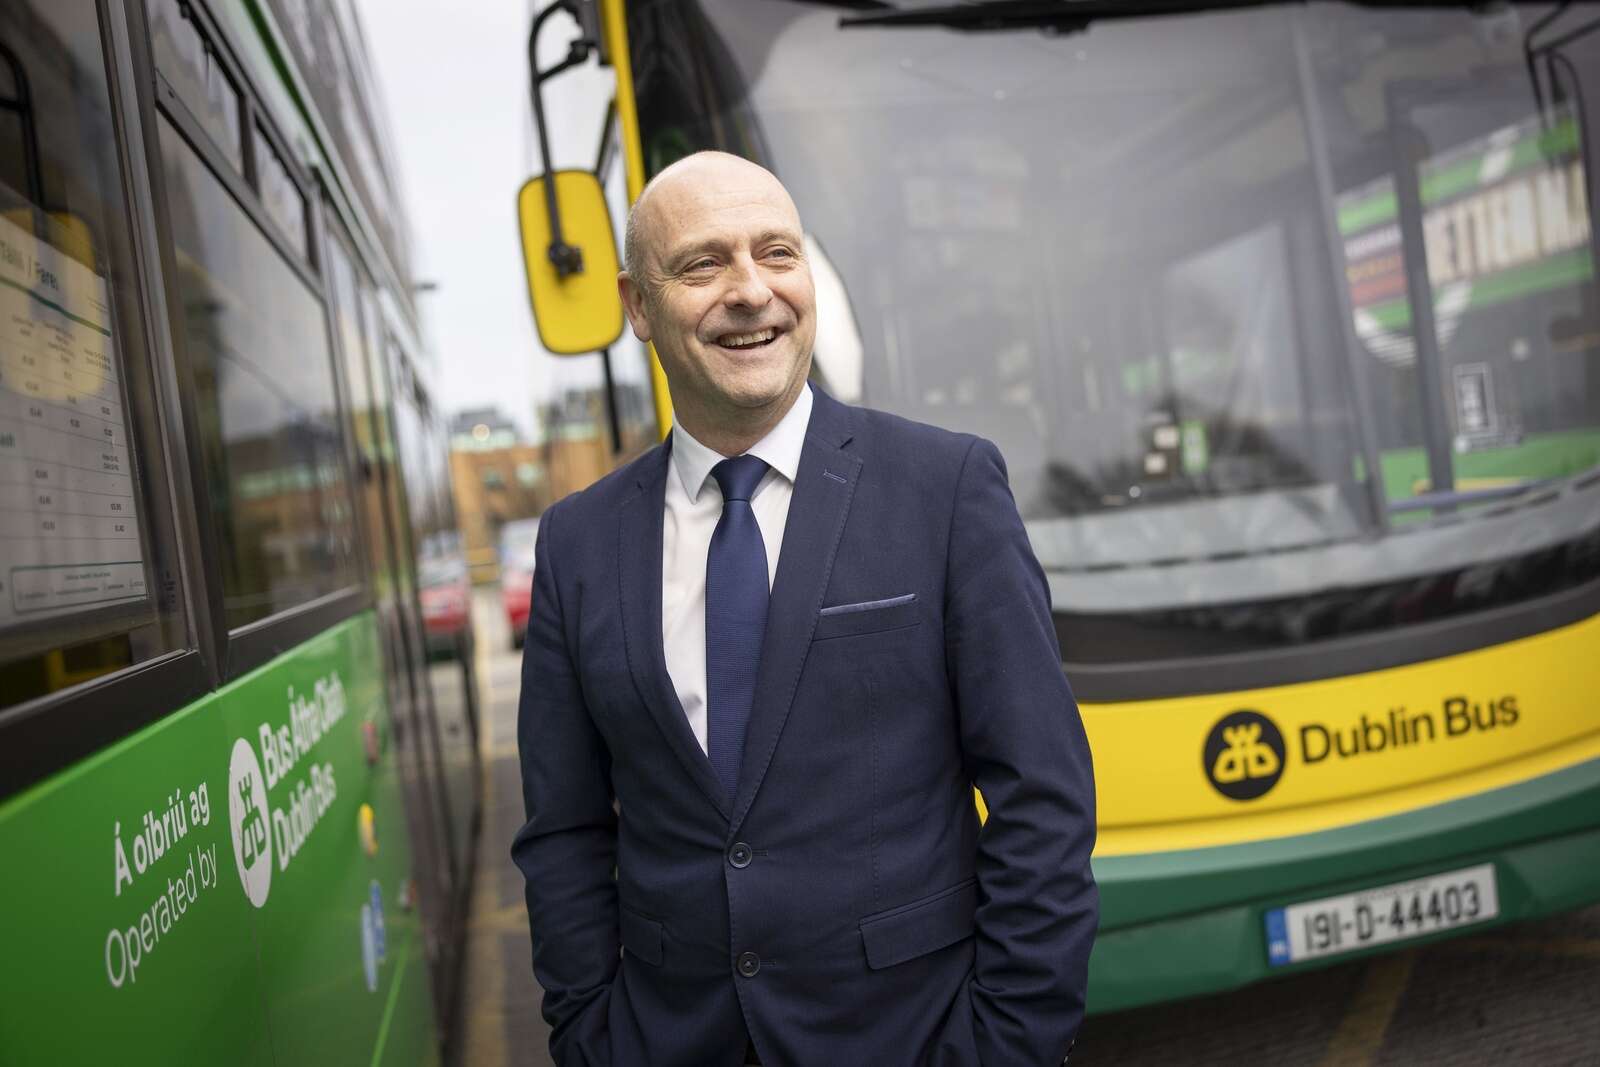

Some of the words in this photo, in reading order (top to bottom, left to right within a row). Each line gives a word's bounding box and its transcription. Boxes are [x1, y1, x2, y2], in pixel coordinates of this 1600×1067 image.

[259, 721, 295, 790] Bus
[1299, 707, 1436, 766] Dublin
[1443, 694, 1520, 740] Bus
[114, 820, 133, 897] Á
[133, 788, 188, 875] oibriú
[189, 781, 211, 826] ag
[272, 779, 318, 872] Dublin
[310, 762, 337, 818] Bus
[105, 852, 198, 988] Operated
[196, 842, 217, 888] by
[1303, 881, 1483, 952] 191-D-44403
